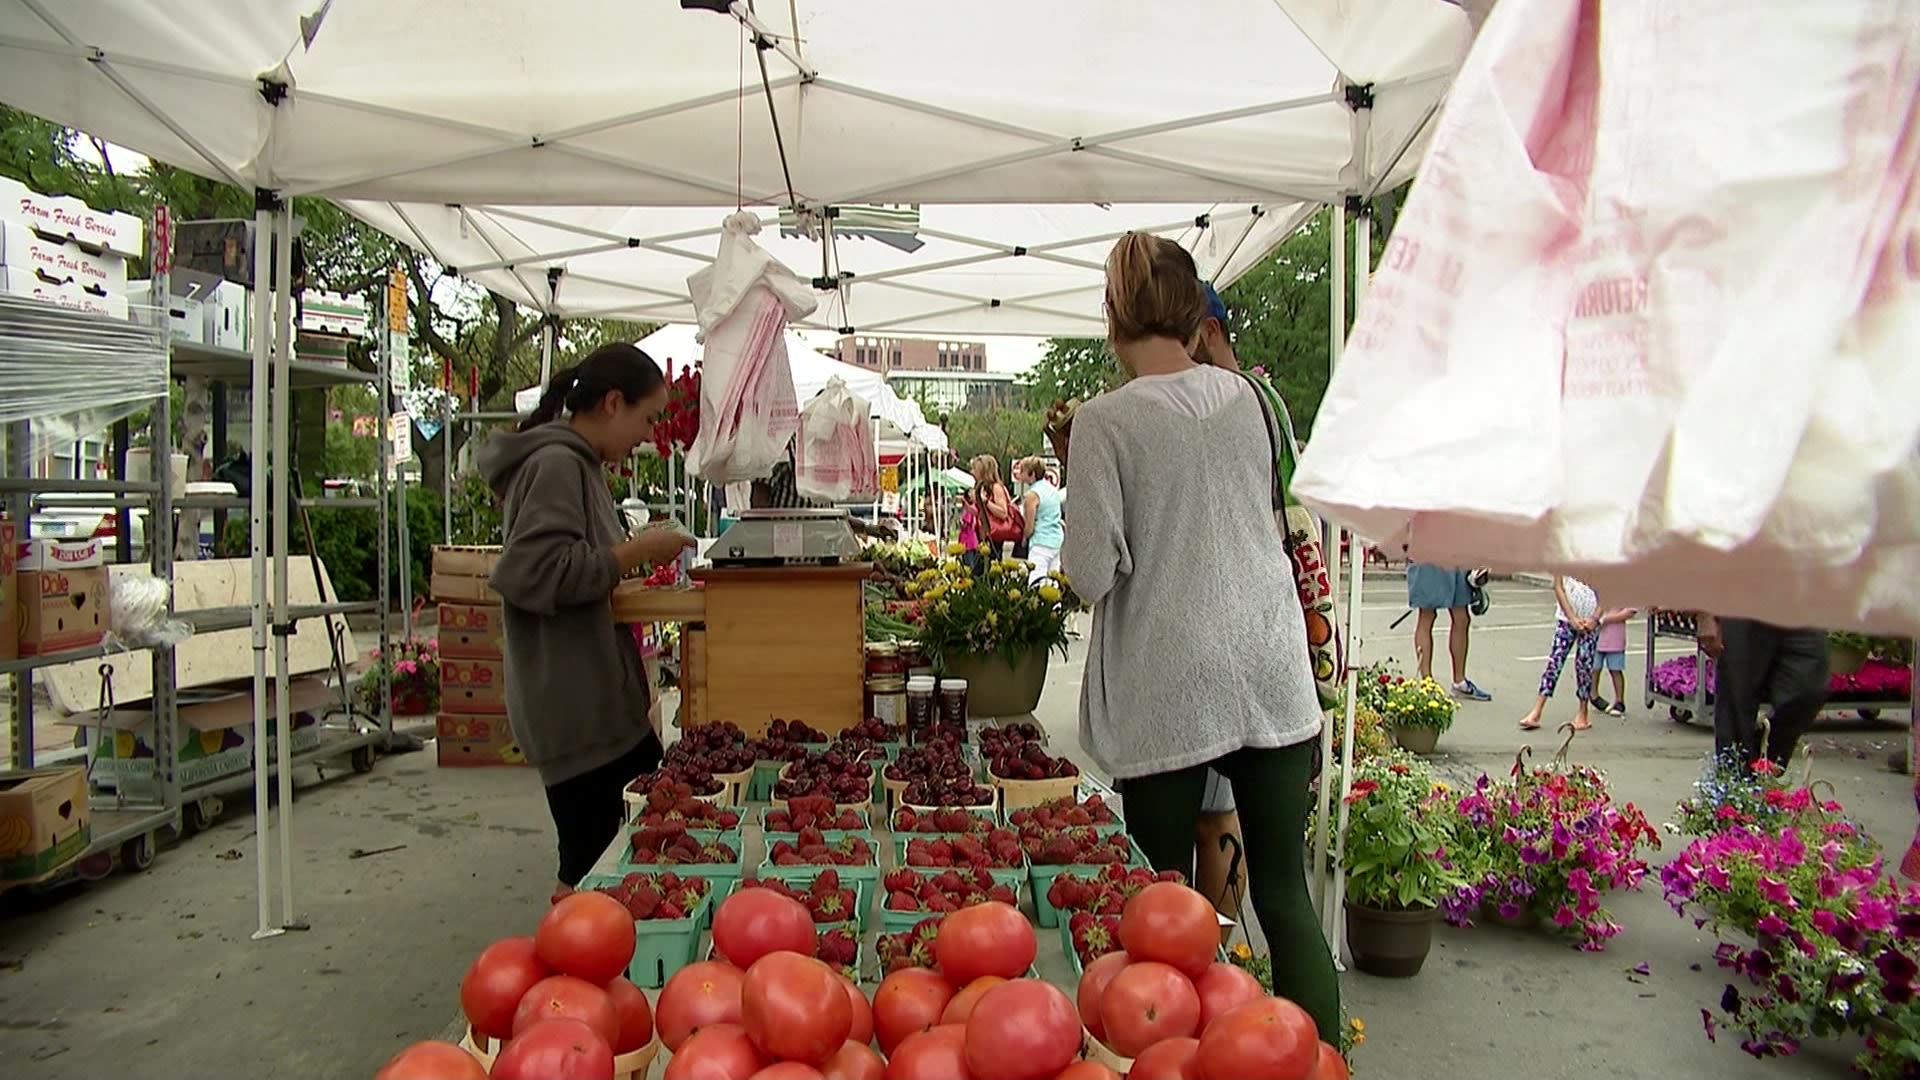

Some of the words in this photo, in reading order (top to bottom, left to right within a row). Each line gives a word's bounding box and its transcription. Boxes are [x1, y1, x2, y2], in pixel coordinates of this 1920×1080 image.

[20, 199, 49, 218] Farm
[53, 208, 81, 226] Fresh
[84, 217, 117, 237] Berries
[30, 246, 54, 263] Farm
[56, 254, 79, 271] Fresh
[81, 261, 107, 279] Berries
[41, 573, 69, 594] Dole
[440, 607, 489, 627] Dole
[442, 662, 493, 683] Dole
[439, 717, 490, 737] Dole
